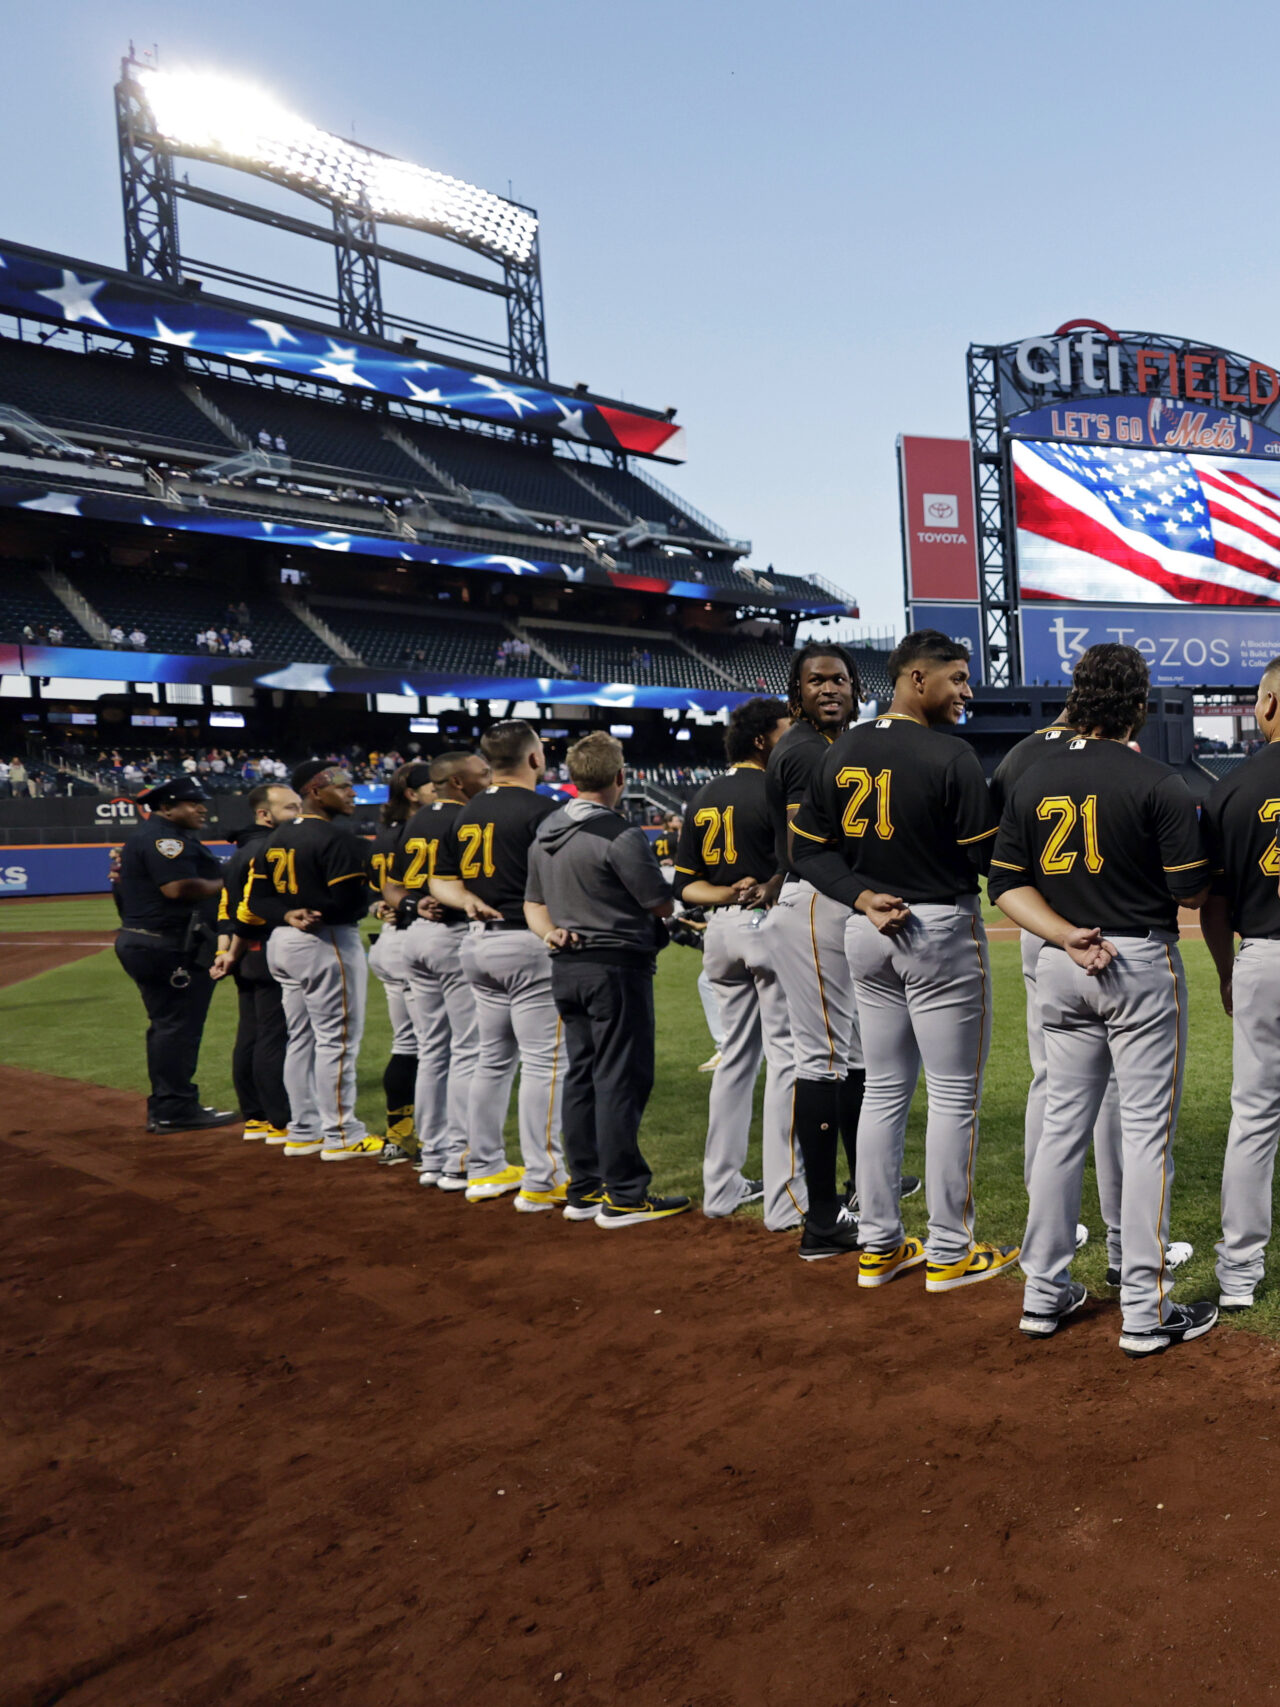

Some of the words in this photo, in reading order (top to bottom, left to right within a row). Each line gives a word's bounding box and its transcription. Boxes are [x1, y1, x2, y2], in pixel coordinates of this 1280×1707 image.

[1016, 332, 1121, 391] citi
[1136, 349, 1280, 405] FIELD
[1051, 411, 1110, 440] LET'S
[1116, 416, 1143, 442] GO
[1164, 410, 1236, 450] Mets
[917, 532, 967, 544] TOYOTA
[1106, 628, 1230, 667] Tezos
[96, 801, 134, 817] citi
[835, 766, 894, 840] 21
[457, 822, 495, 879] 21
[656, 839, 669, 856] 21
[694, 806, 737, 865] 21
[1036, 795, 1104, 875] 21
[266, 848, 298, 894] 21
[403, 838, 440, 889] 21
